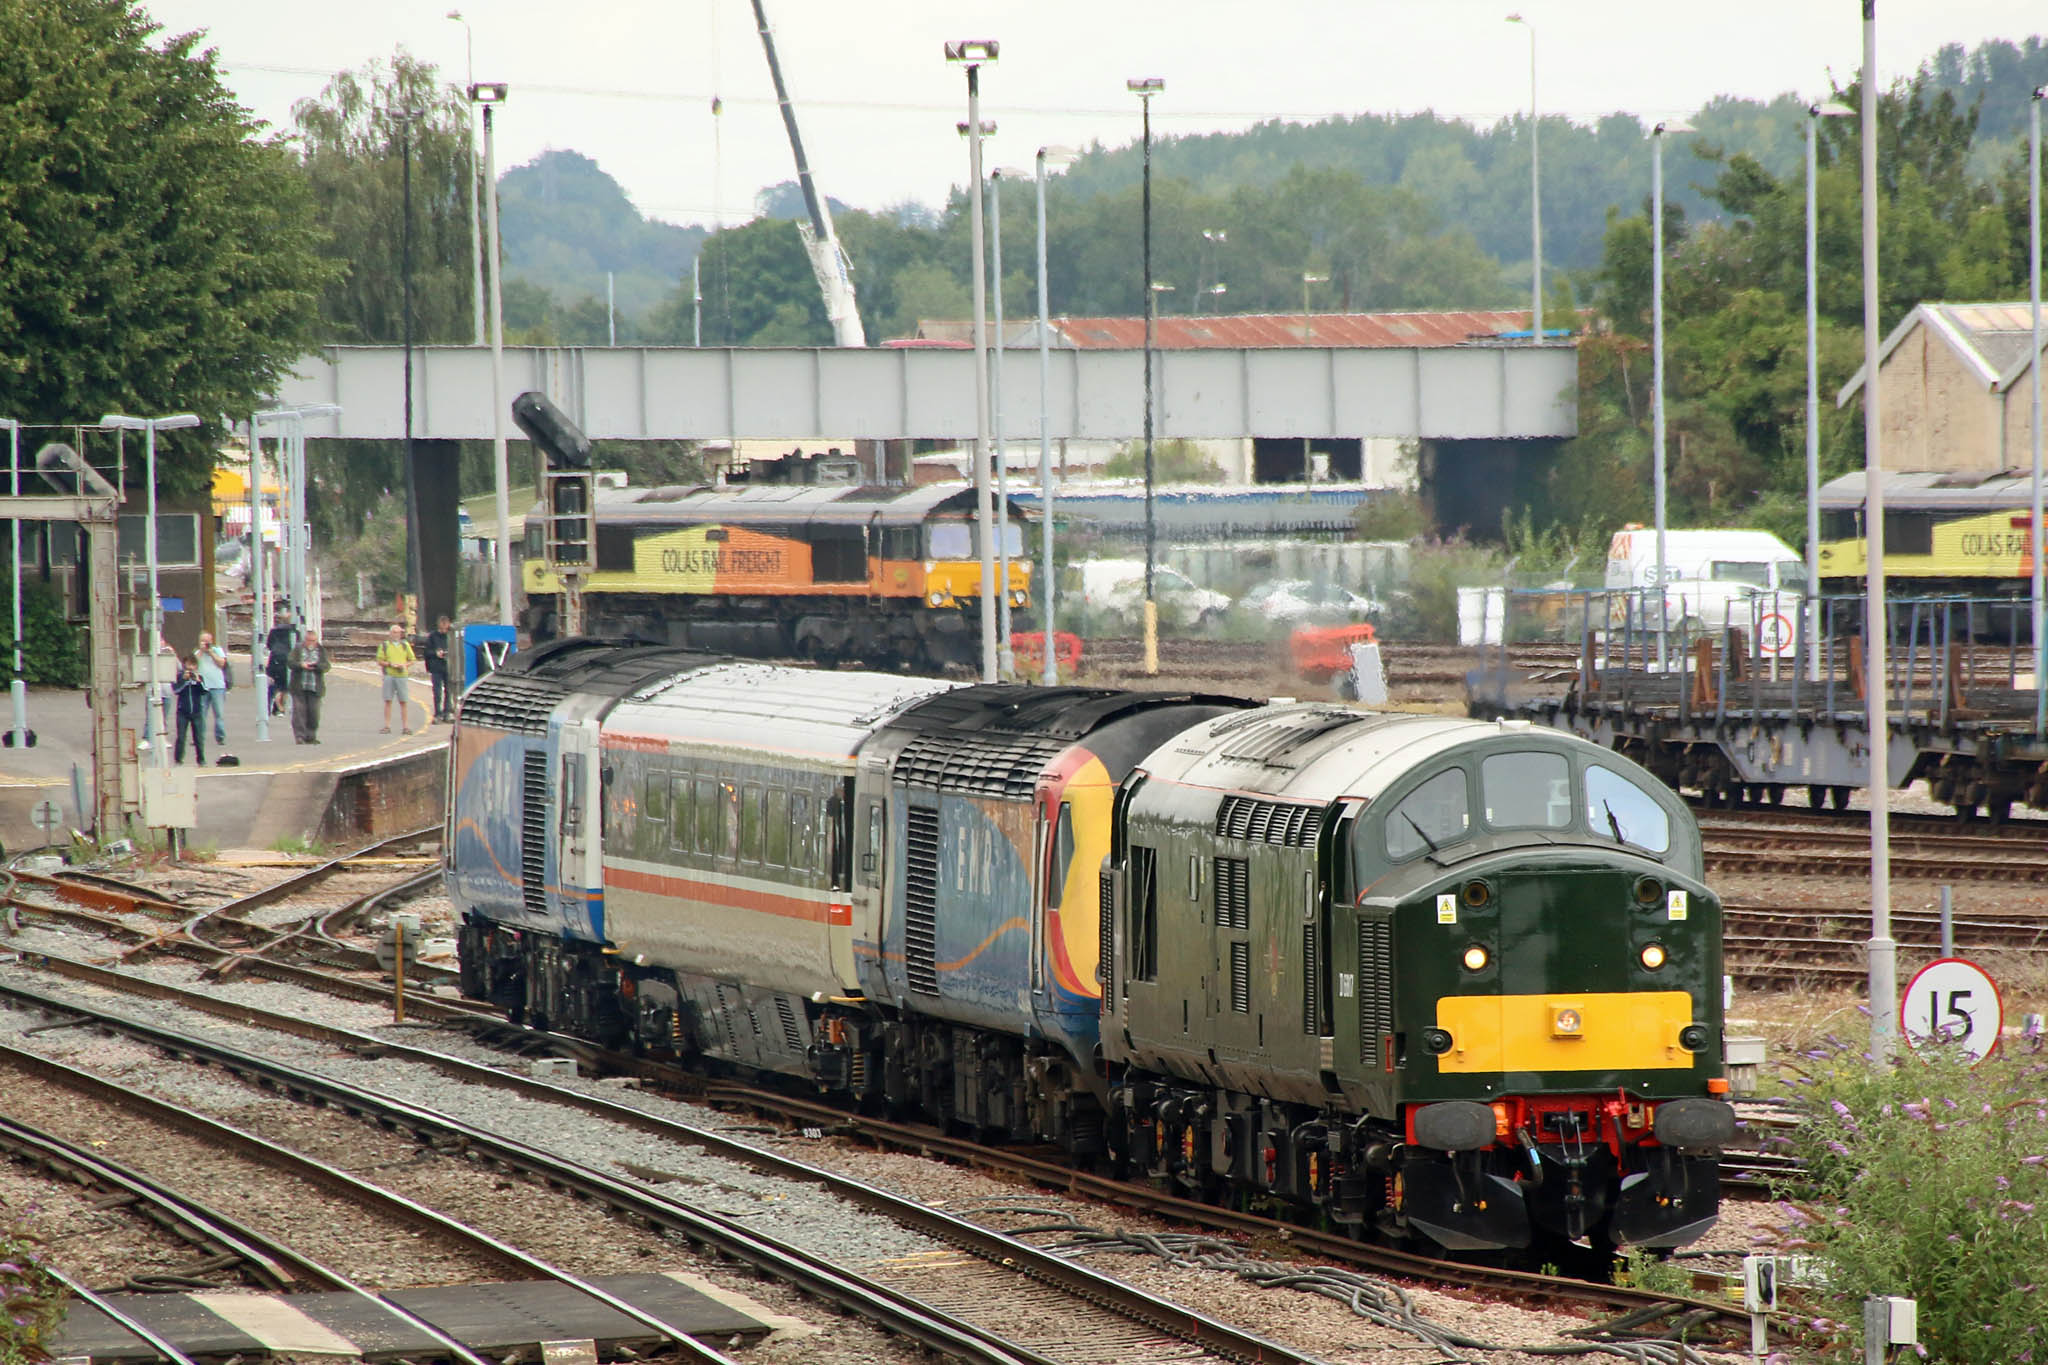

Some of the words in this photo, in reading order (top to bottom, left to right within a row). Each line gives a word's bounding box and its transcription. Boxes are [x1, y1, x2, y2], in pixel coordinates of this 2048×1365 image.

[1961, 533, 2002, 556] COLAS
[662, 549, 699, 573] COLAS
[701, 549, 729, 573] RAIL
[731, 549, 781, 573] FREIGHT
[1931, 990, 1973, 1040] 15
